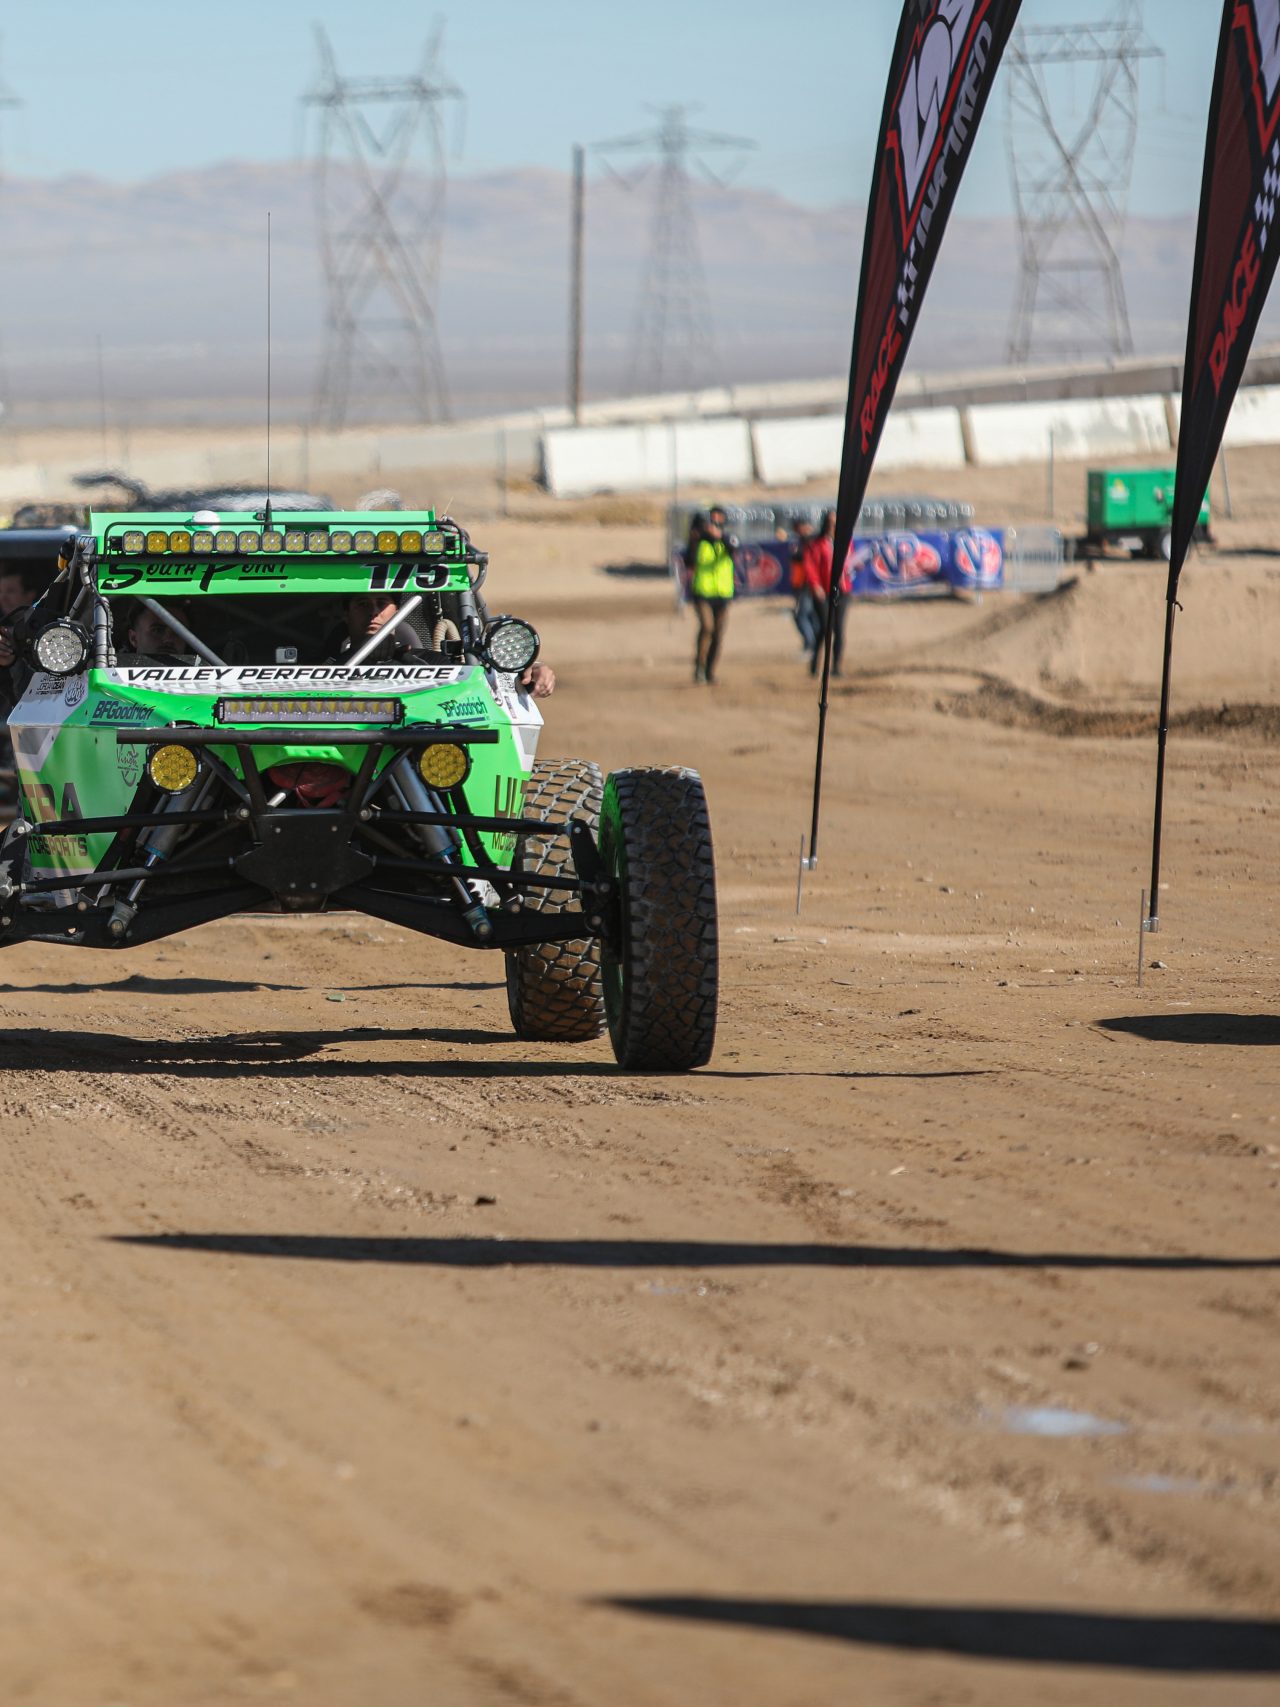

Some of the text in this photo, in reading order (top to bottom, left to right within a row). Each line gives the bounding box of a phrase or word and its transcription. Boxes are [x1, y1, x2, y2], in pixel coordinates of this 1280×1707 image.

[1208, 221, 1262, 396] RACE
[860, 303, 904, 455] RACE
[360, 563, 449, 591] 175
[127, 667, 456, 682] VALLEY PERFORMANCE
[92, 700, 156, 721] BFGoodrich
[438, 696, 488, 717] BFGoodrich
